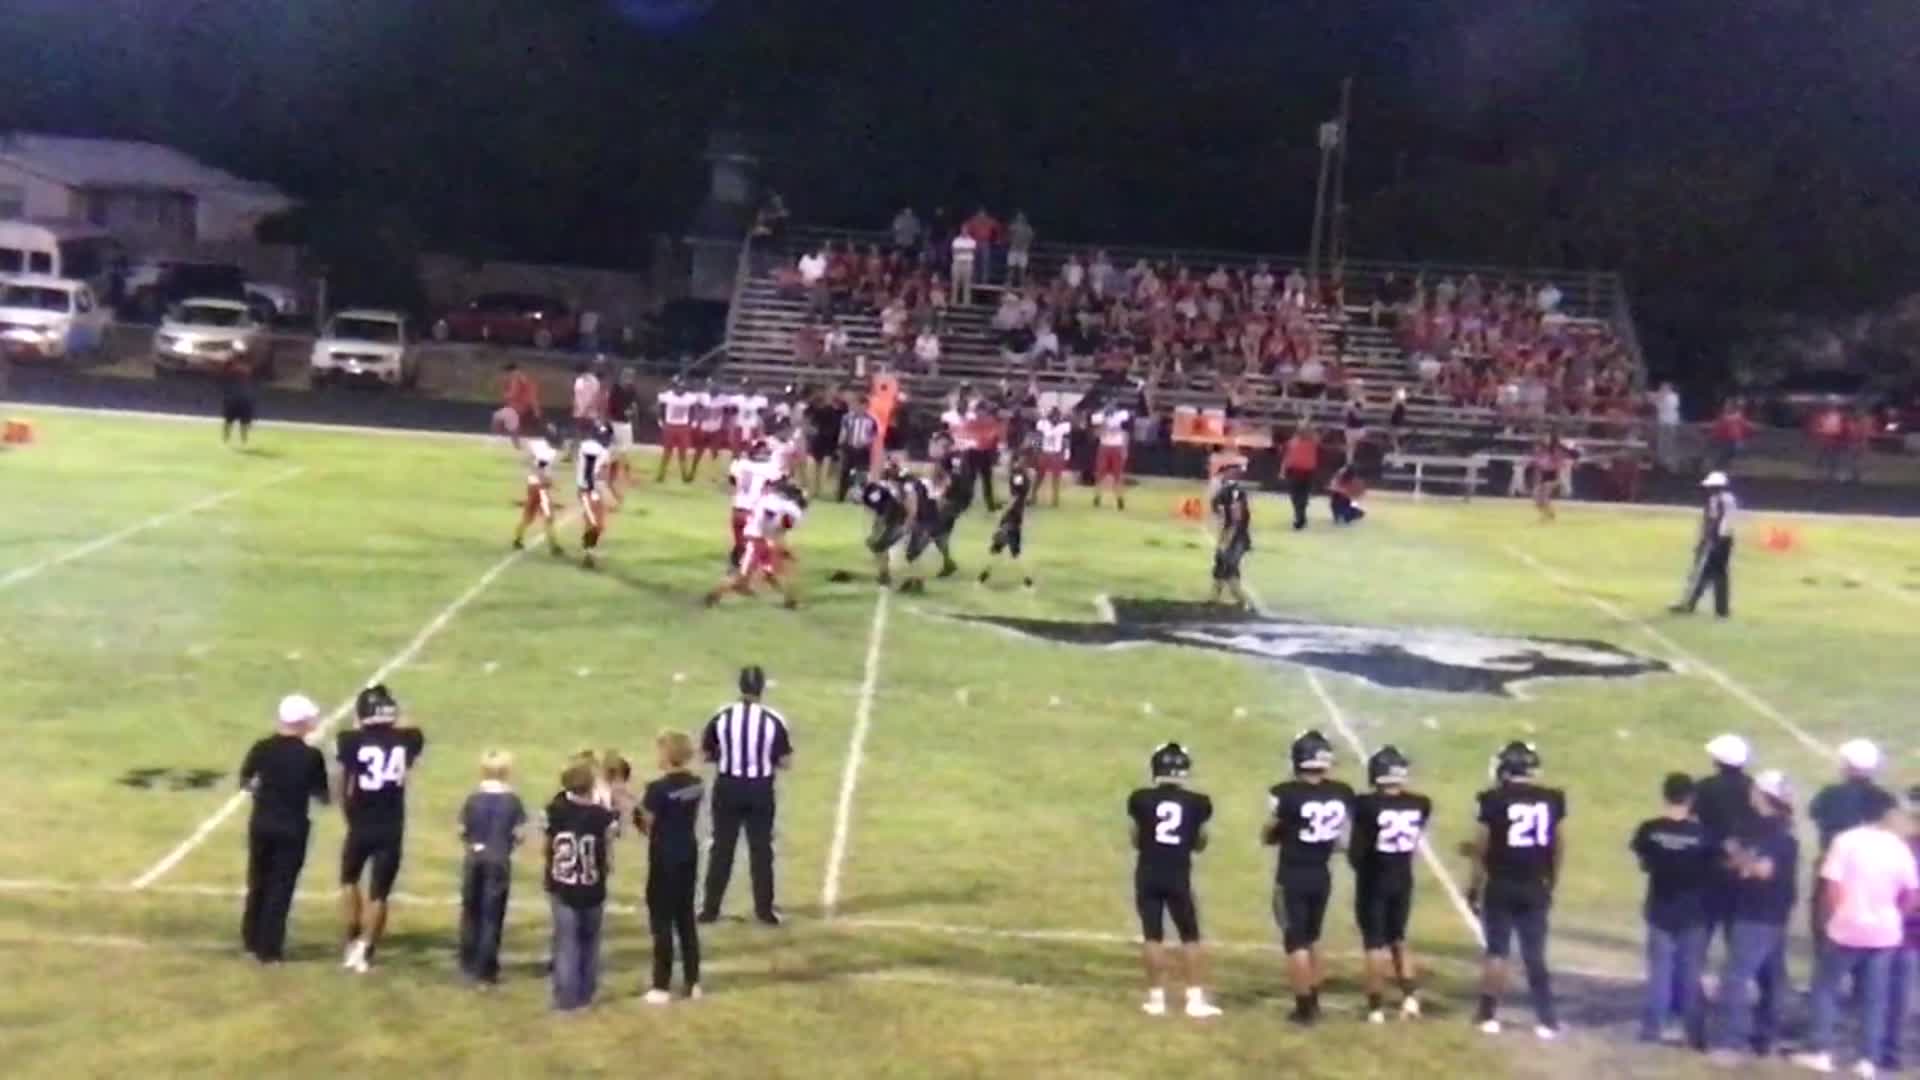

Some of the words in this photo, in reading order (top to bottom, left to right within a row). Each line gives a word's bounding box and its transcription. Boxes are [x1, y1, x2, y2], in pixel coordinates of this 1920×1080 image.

[357, 745, 406, 790] 34
[1155, 800, 1182, 845] 2
[1299, 799, 1345, 843] 32
[1376, 809, 1422, 853] 25
[1507, 802, 1549, 847] 21
[552, 831, 600, 885] 21
